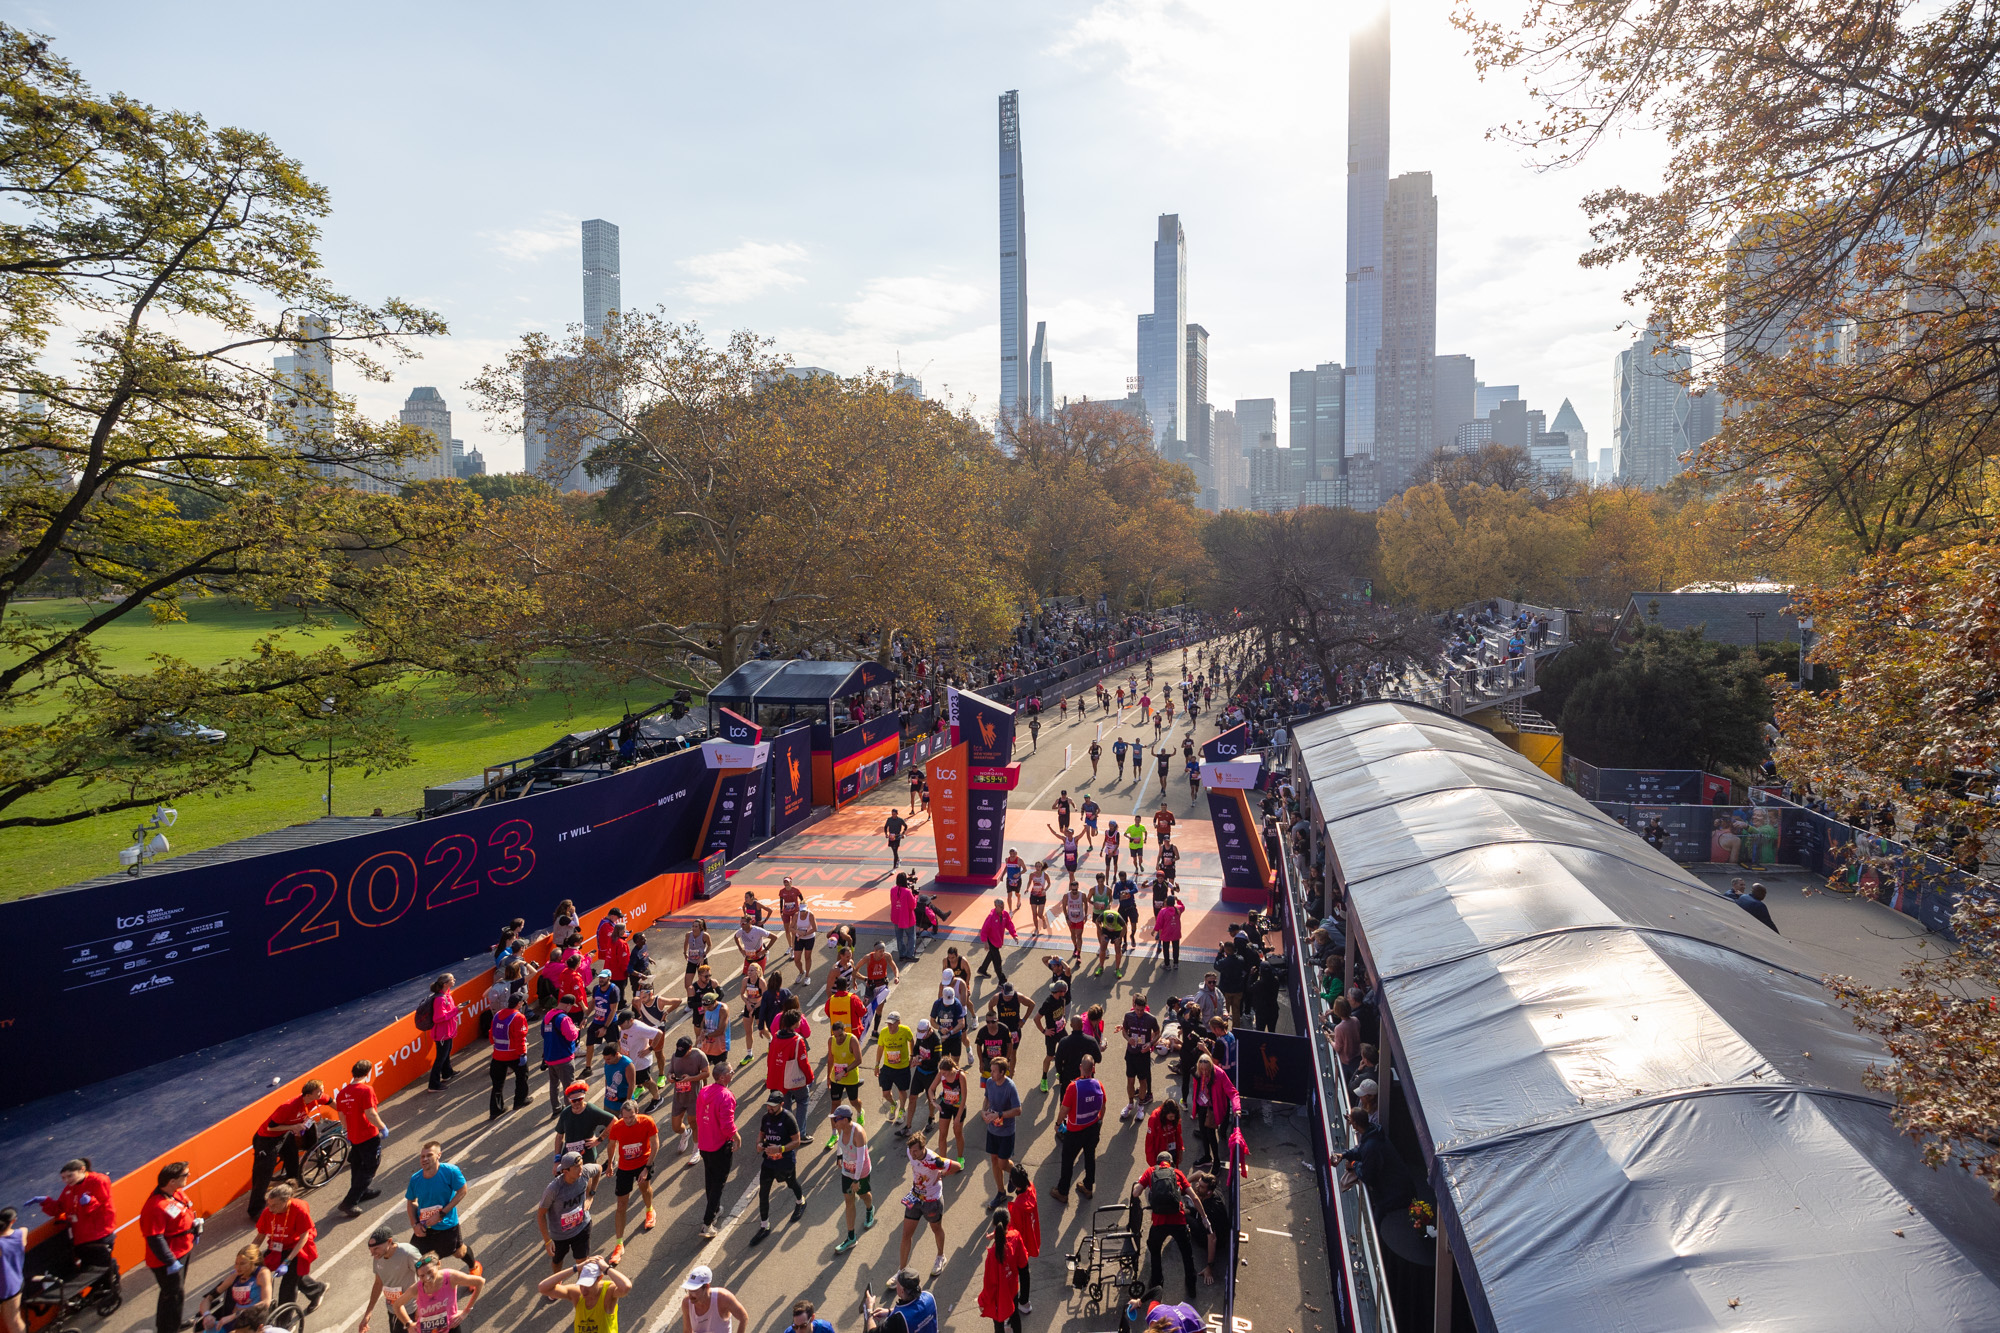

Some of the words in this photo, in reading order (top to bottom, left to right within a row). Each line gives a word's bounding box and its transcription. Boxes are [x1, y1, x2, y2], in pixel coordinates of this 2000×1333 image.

[950, 695, 960, 722] 2023
[730, 726, 747, 737] tcs
[1217, 741, 1237, 755] tcs
[936, 767, 957, 780] tcs
[558, 831, 568, 842] IT
[570, 825, 592, 838] WILL
[657, 794, 674, 806] MOVE
[675, 789, 687, 799] YOU
[799, 837, 937, 853] INISH
[265, 818, 537, 956] 2023
[630, 902, 647, 920] YOU
[117, 914, 145, 929] tcs
[467, 997, 491, 1019] WIL
[388, 1037, 422, 1067] YOU
[766, 1133, 782, 1142] NYPD
[563, 1195, 583, 1209] MAT
[1173, 1308, 1186, 1321] EMT
[577, 1324, 599, 1332] TEAM
